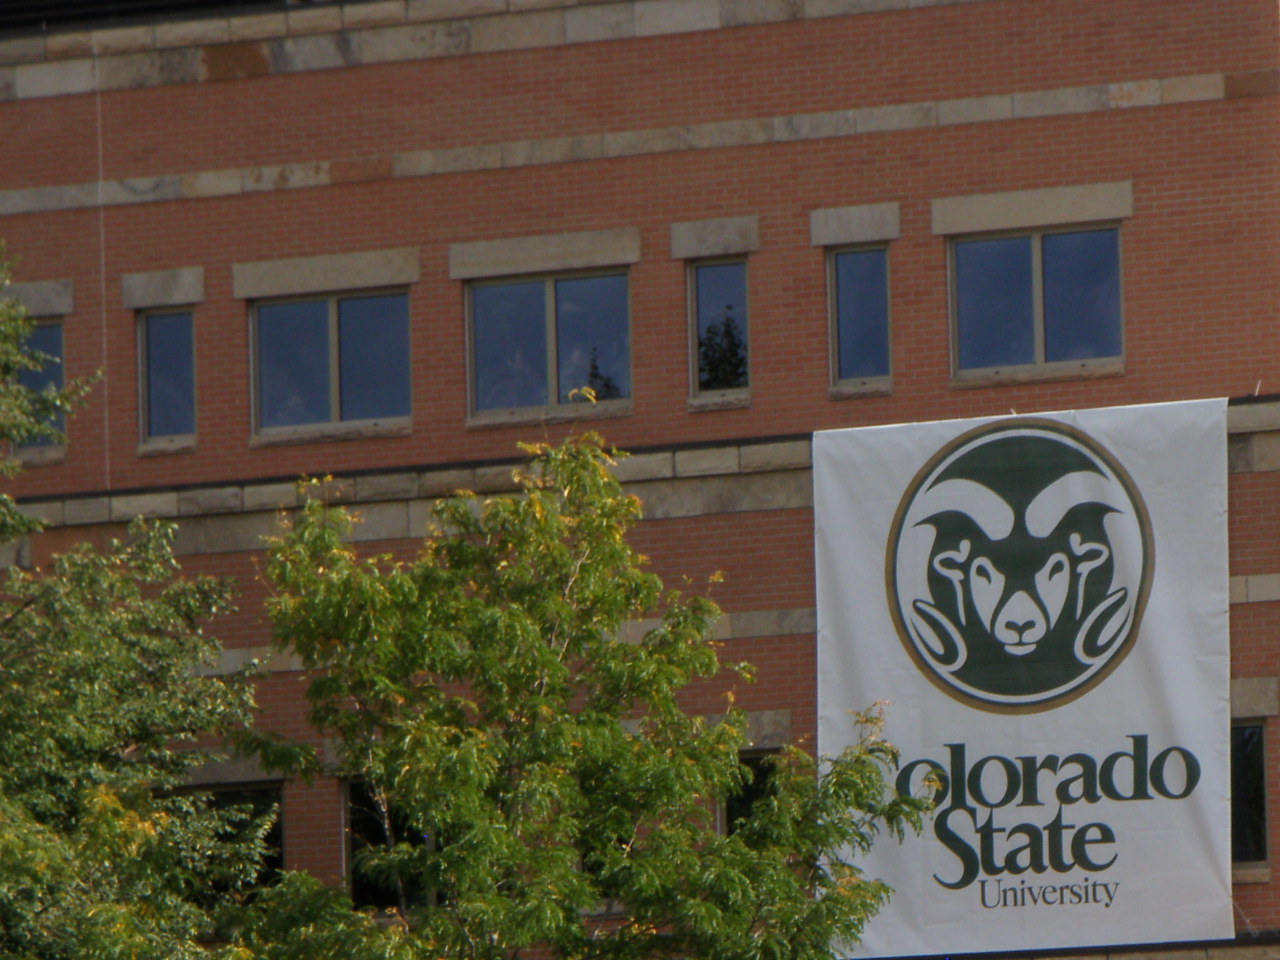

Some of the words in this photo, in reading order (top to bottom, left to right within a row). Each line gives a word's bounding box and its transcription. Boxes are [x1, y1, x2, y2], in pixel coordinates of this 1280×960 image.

[894, 734, 1201, 809] olorado
[933, 803, 1118, 889] State
[978, 877, 1120, 909] University
